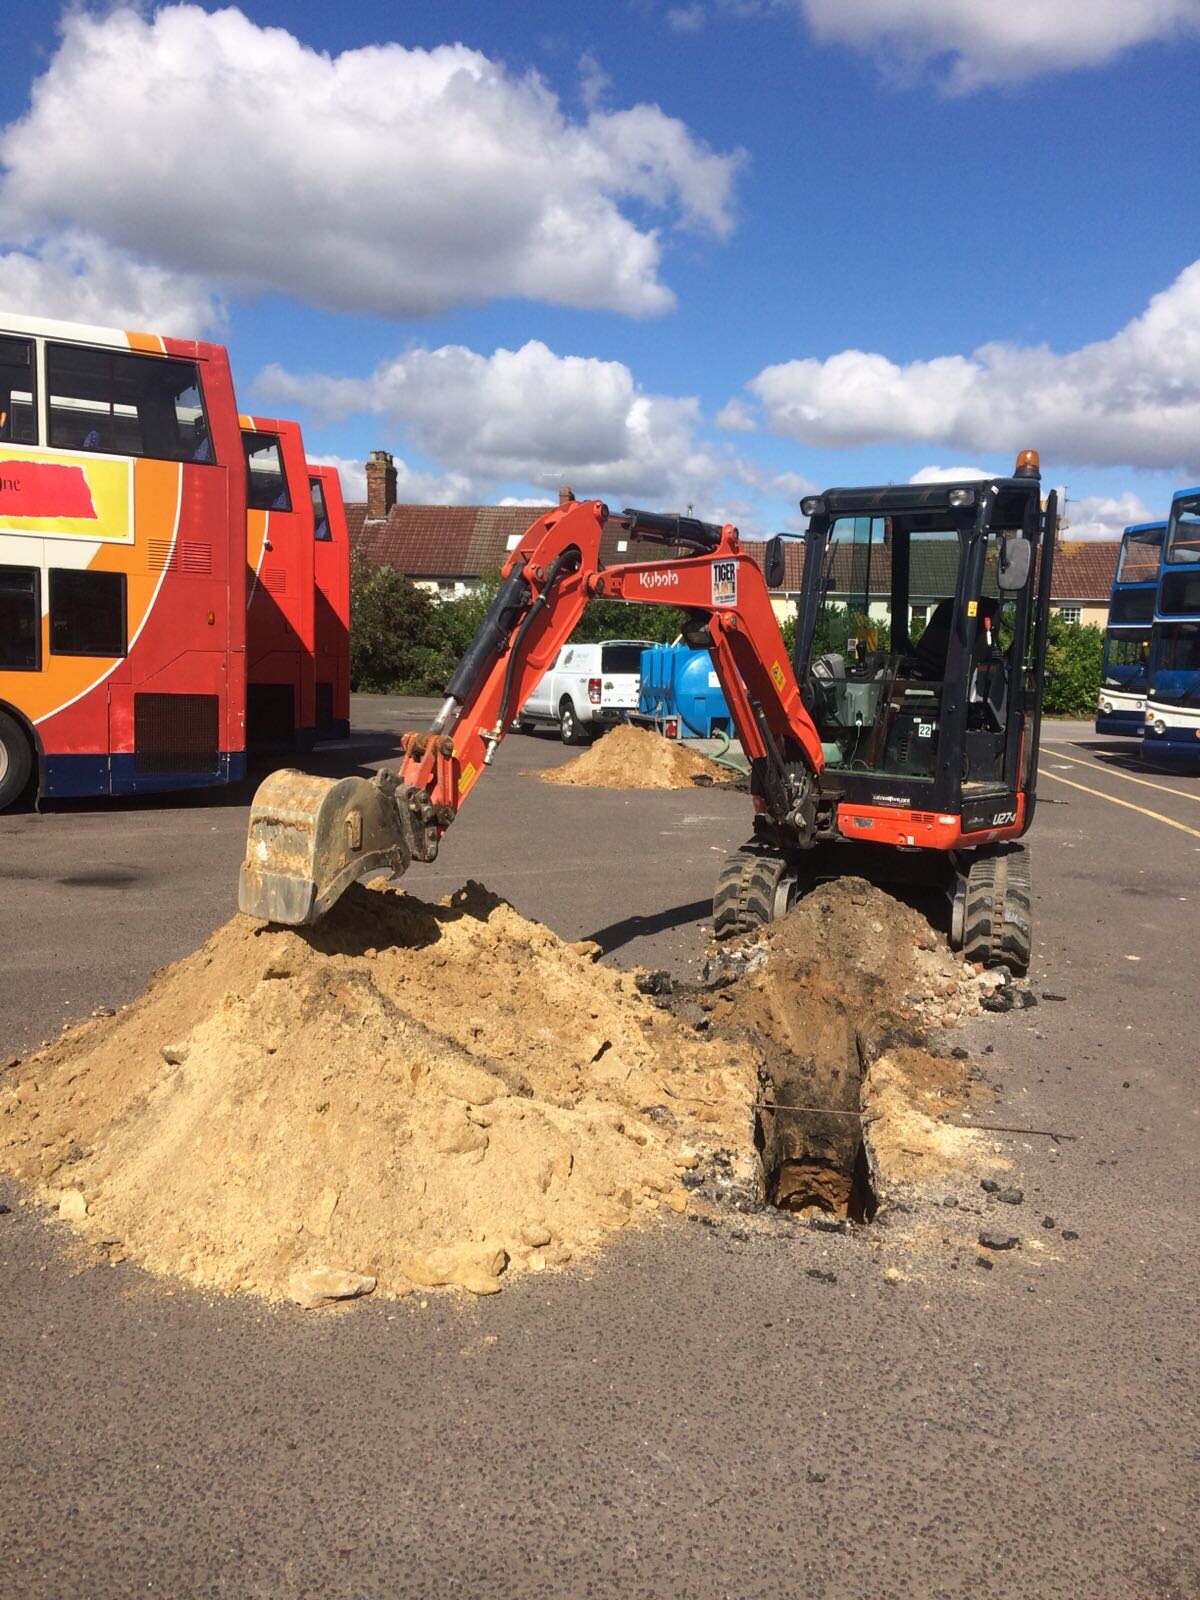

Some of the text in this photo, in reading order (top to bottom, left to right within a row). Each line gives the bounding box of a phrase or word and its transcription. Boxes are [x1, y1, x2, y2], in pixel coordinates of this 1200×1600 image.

[639, 569, 679, 589] Kubota
[713, 563, 736, 582] TIGER
[919, 725, 931, 736] 22
